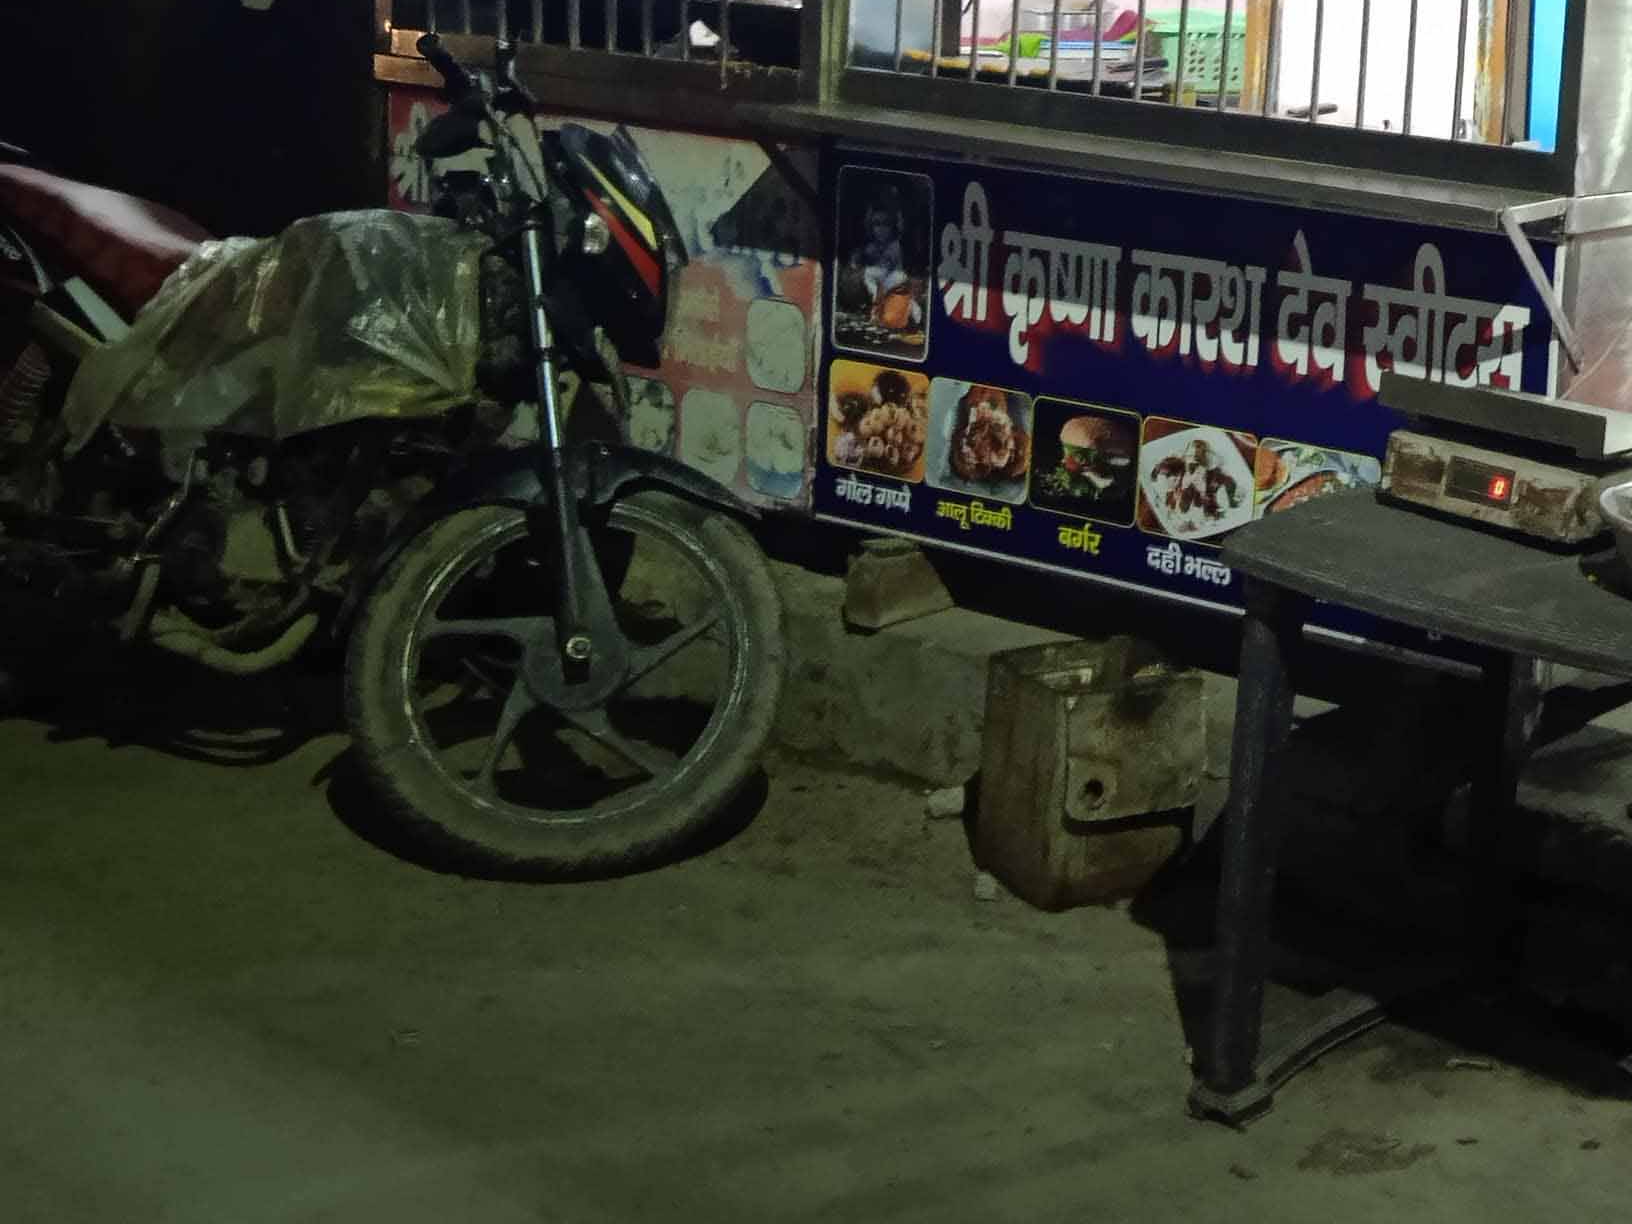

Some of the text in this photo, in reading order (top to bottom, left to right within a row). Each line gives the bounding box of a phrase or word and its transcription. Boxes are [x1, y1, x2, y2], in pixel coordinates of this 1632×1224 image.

[937, 180, 993, 325] श्री
[1002, 228, 1124, 367] कृष्णा
[1277, 230, 1353, 382] देव
[1145, 542, 1183, 574] दही
